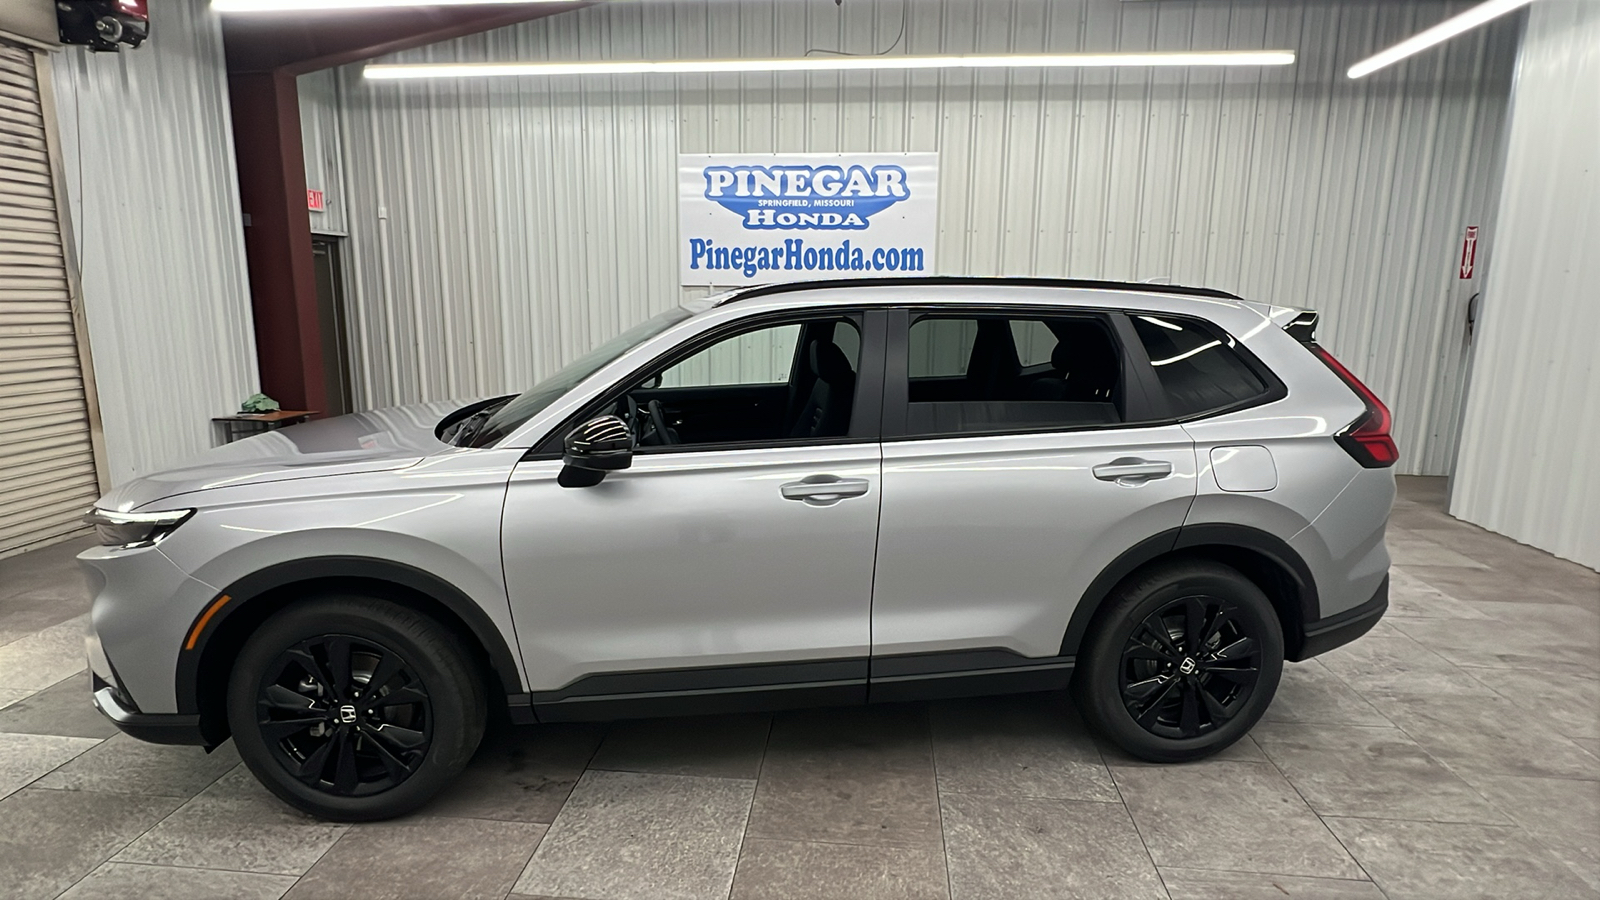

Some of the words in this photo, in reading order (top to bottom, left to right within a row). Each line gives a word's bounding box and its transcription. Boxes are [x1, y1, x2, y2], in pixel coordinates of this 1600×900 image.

[707, 169, 907, 198] PINEGAR
[307, 190, 324, 210] EXIT
[757, 199, 812, 208] SPRINGFIELD,
[813, 199, 855, 207] MISSOURI
[747, 209, 865, 226] HONDA
[689, 238, 924, 278] PinegarHonda.com
